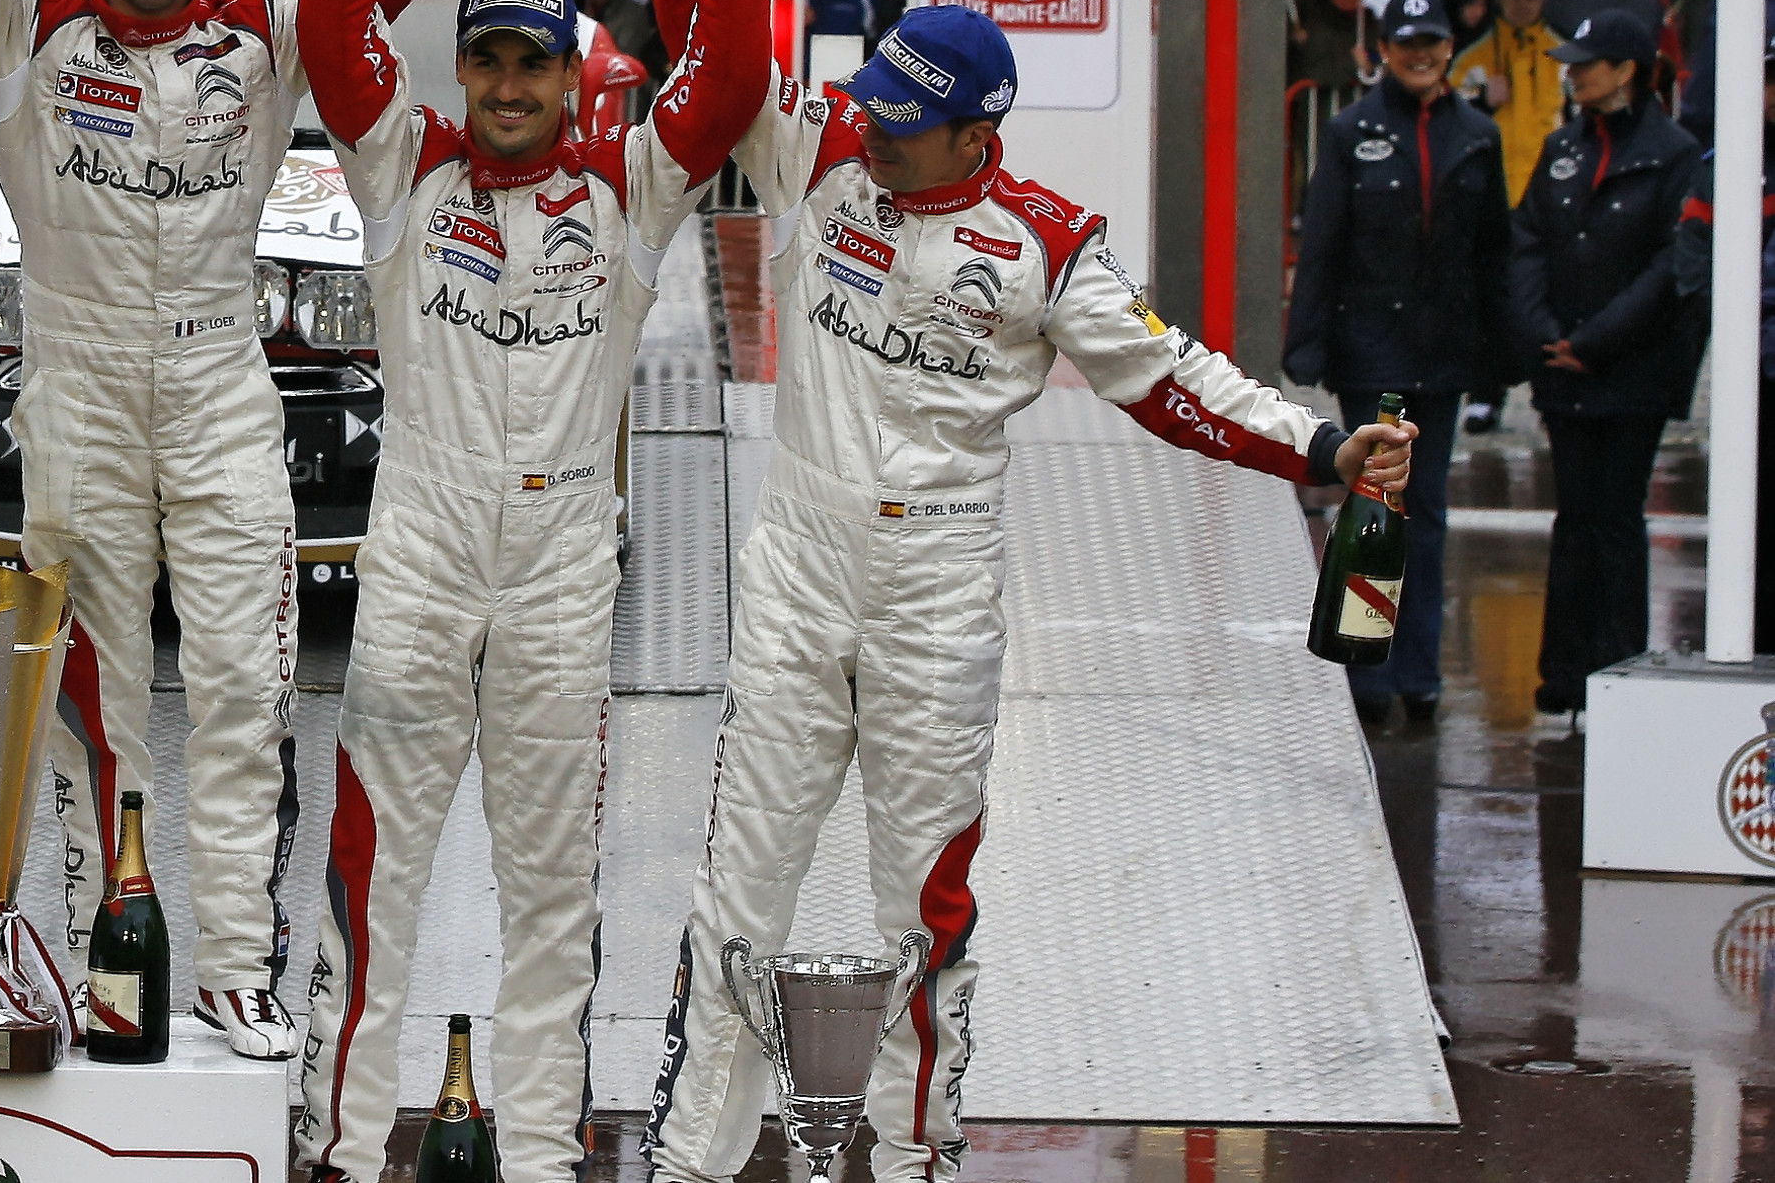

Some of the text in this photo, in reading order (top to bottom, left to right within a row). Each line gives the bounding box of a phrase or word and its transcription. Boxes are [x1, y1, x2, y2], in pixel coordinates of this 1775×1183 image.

[886, 37, 948, 88] MICHELIN
[80, 81, 136, 107] TOTAL
[662, 45, 705, 115] TOAL
[780, 78, 795, 108] OTAL
[76, 114, 132, 135] MICHELIN
[56, 143, 145, 197] Abu
[146, 152, 244, 200] Dhabi
[456, 221, 506, 254] TOTAL
[841, 231, 890, 266] TOTAL
[974, 236, 1019, 257] Santander
[447, 251, 499, 279] MICHELIN
[832, 265, 882, 295] MICHELIN
[197, 316, 236, 332] S. LOEB
[421, 283, 604, 346] Abu Dhabi
[808, 292, 991, 381] Abu Dhabi
[1166, 387, 1231, 449] TOTAL
[561, 466, 596, 483] SORDO
[909, 501, 990, 516] C. DEL BARRIO
[277, 526, 294, 683] CITROËN
[447, 1046, 463, 1088] MUMM
